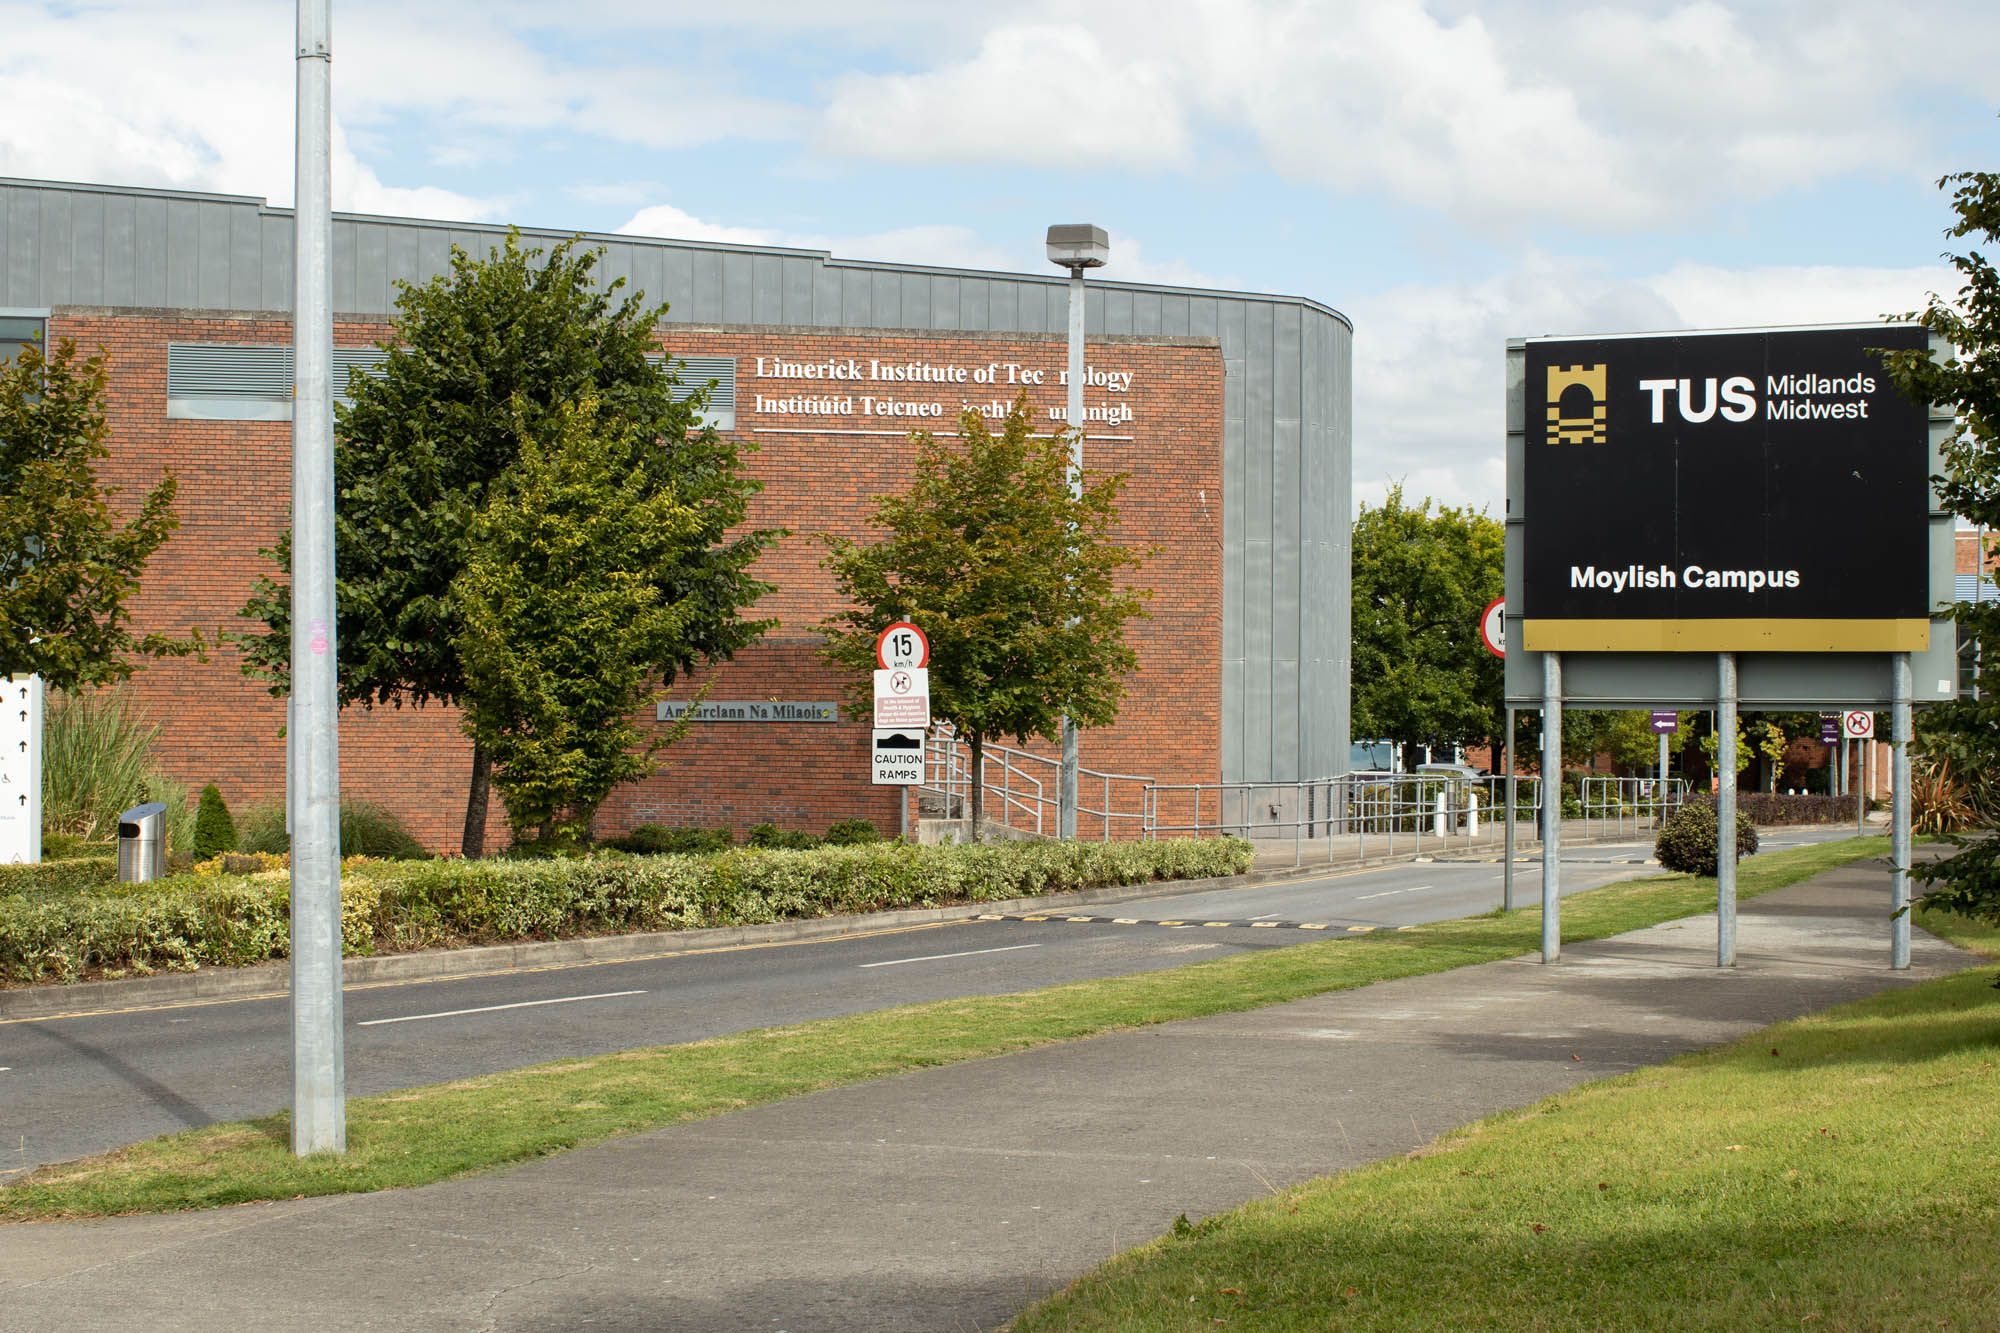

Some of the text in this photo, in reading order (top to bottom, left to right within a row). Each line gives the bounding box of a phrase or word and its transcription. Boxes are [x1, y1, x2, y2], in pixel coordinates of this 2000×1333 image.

[756, 357, 1134, 392] Limerick Institute of Tecnlogy
[1767, 372, 1876, 396] Midlands
[754, 394, 854, 416] Institiúid
[1639, 376, 1757, 424] TUS
[1767, 399, 1868, 421] Midwest
[1570, 565, 1800, 594] Moylish Campus
[892, 634, 912, 657] 15
[894, 659, 913, 669] km/h
[750, 705, 768, 719] Na
[875, 755, 922, 764] CAUTION
[879, 770, 917, 779] RAMPS
